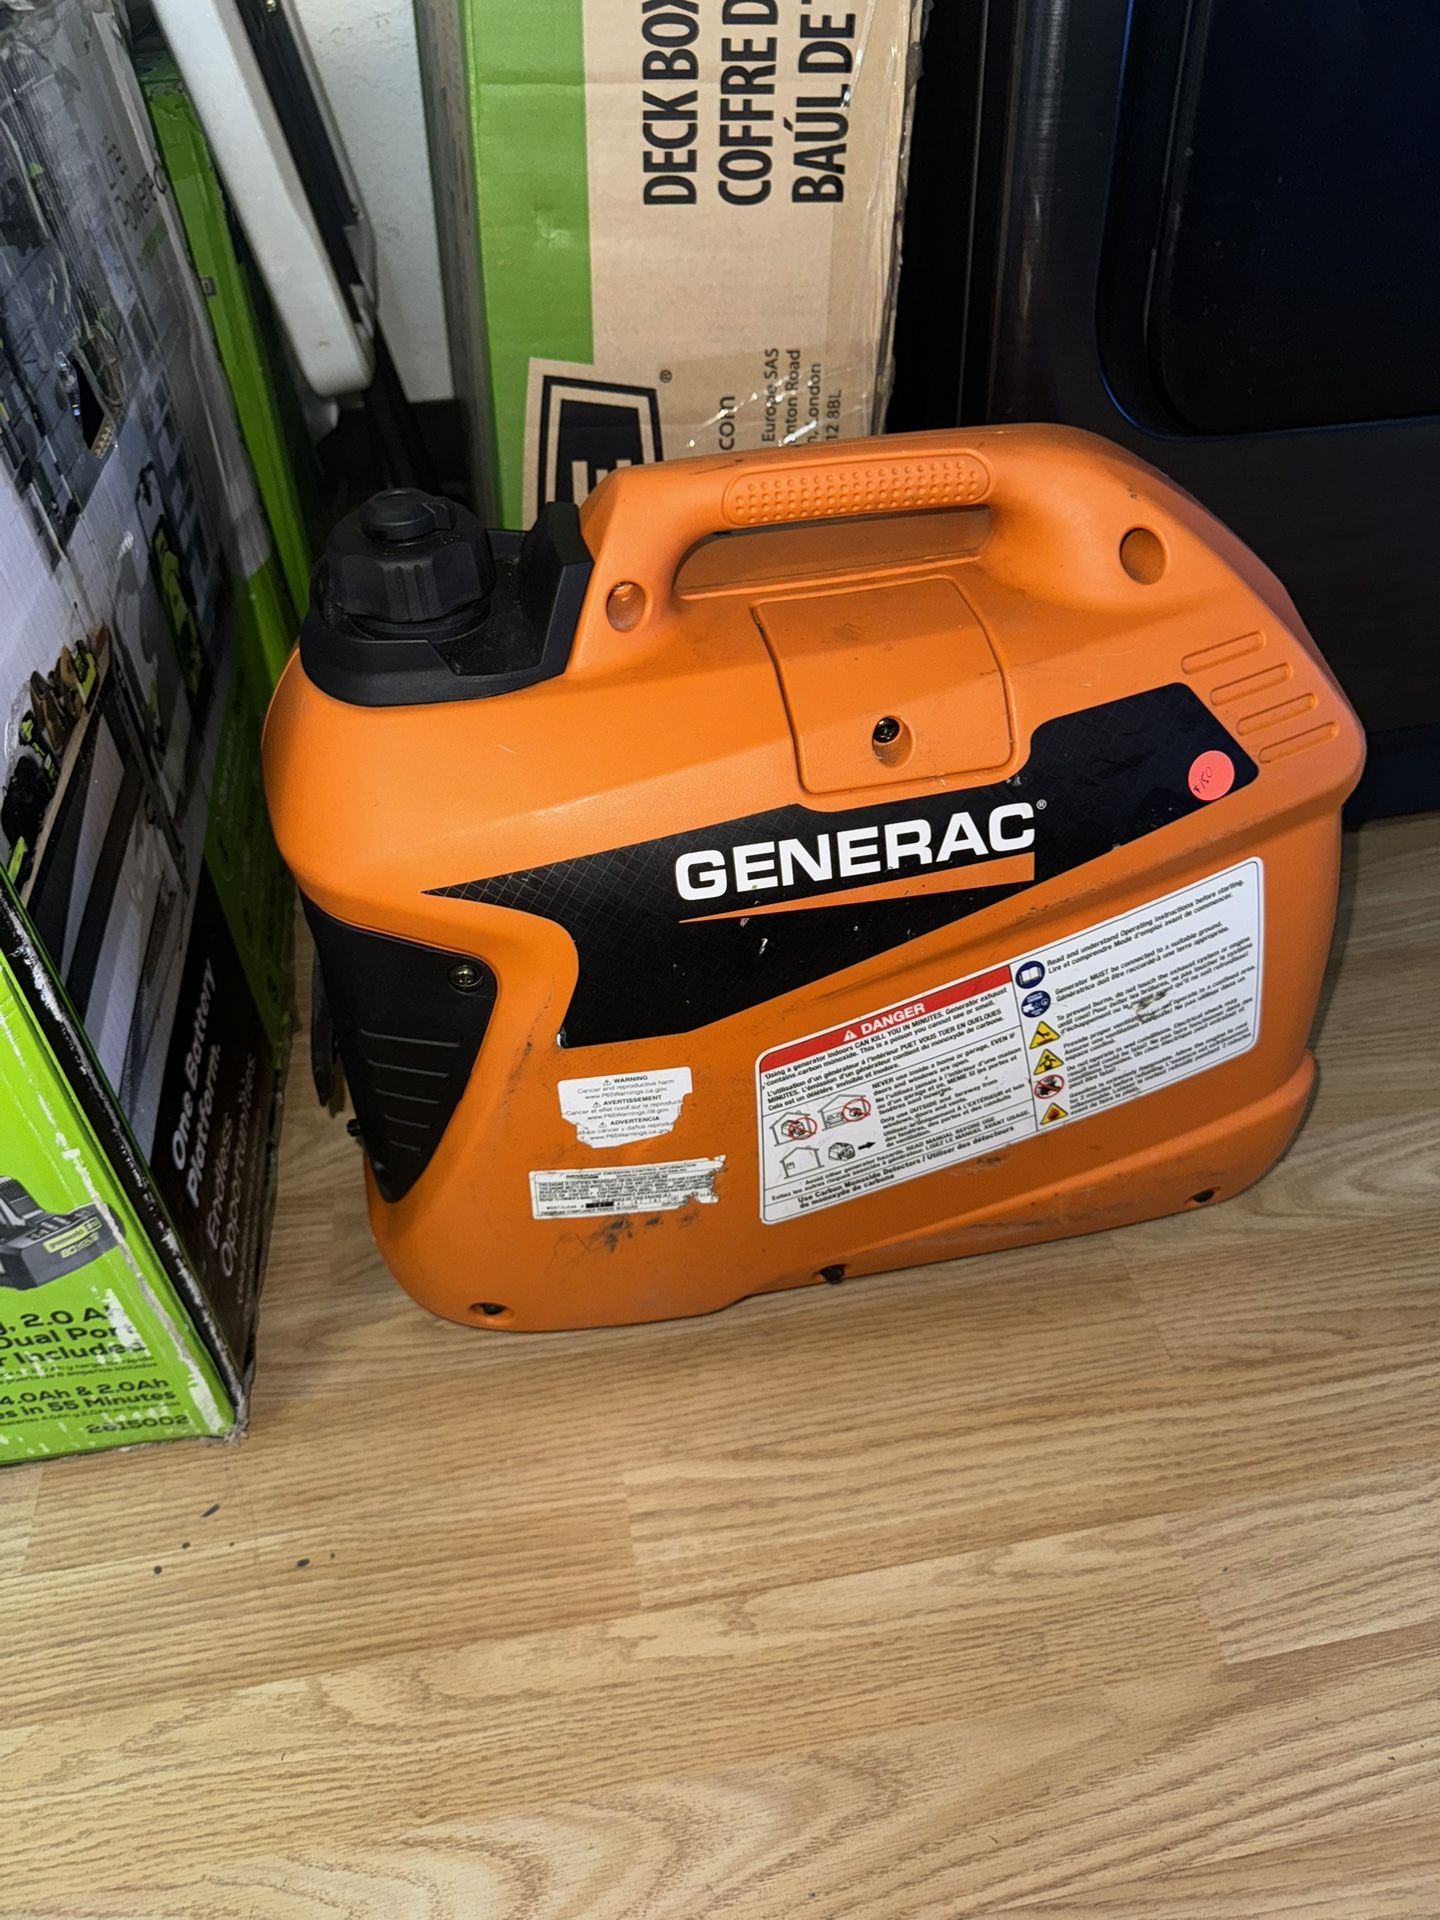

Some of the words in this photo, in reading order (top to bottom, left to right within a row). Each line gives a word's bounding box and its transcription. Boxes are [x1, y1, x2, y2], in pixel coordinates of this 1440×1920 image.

[797, 13, 856, 74] DE
[642, 90, 698, 205] DECK
[718, 37, 778, 206] COFFRE
[783, 84, 851, 203] BAÚL
[764, 348, 779, 379] SAS
[785, 350, 801, 392] Road
[762, 384, 779, 442] Europe
[827, 389, 842, 419] 8BL
[675, 802, 1035, 901] GENERAC
[1046, 954, 1064, 966] Read
[1065, 948, 1078, 959] and
[1080, 932, 1118, 953] understand
[1120, 919, 1152, 936] Operating
[1154, 901, 1193, 922] Instructions
[1194, 891, 1216, 904] before
[1217, 879, 1244, 894] starting.
[764, 1068, 785, 1080] Using
[793, 1054, 825, 1072] generator
[827, 1044, 853, 1058] indoors
[854, 1037, 869, 1048] CAN
[871, 1031, 885, 1042] KILL
[888, 1026, 901, 1036] YOU
[902, 1022, 910, 1031] IN
[911, 1010, 943, 1027] MINUTES.
[945, 998, 978, 1015] Generator
[979, 986, 1007, 1002] exhaust
[766, 1072, 795, 1086] contains
[797, 1063, 822, 1075] carbon
[823, 1050, 858, 1067] monoxide.
[860, 1044, 874, 1053] This
[889, 1030, 912, 1044] poison
[913, 1025, 926, 1035] you
[927, 1015, 951, 1029] cannot
[952, 1011, 964, 1020] see
[974, 999, 994, 1011] smell.
[860, 1001, 925, 1034] DANGER
[171, 1091, 194, 1171] One
[184, 958, 217, 1091] Battery
[614, 1075, 648, 1083] WARNING
[603, 1095, 662, 1106] AVERTISSEMENT
[610, 1116, 660, 1126] ADVERTENCIA
[205, 1112, 233, 1250] Endless
[218, 1052, 257, 1278] Opportunities
[797, 1194, 812, 1203] Use
[814, 1184, 842, 1197] Carbon
[844, 1171, 880, 1188] Monoxide
[882, 1158, 920, 1175] Detectors
[926, 1146, 954, 1160] Utiliser
[956, 1140, 971, 1149] des
[972, 1126, 1014, 1144] détecteurs
[20, 1310, 74, 1328] 2.0
[20, 1406, 44, 1416] in
[47, 1400, 79, 1411] 55
[83, 1391, 176, 1408] Minutes
[76, 1385, 93, 1397] &
[96, 1378, 169, 1394] 2.0Ah
